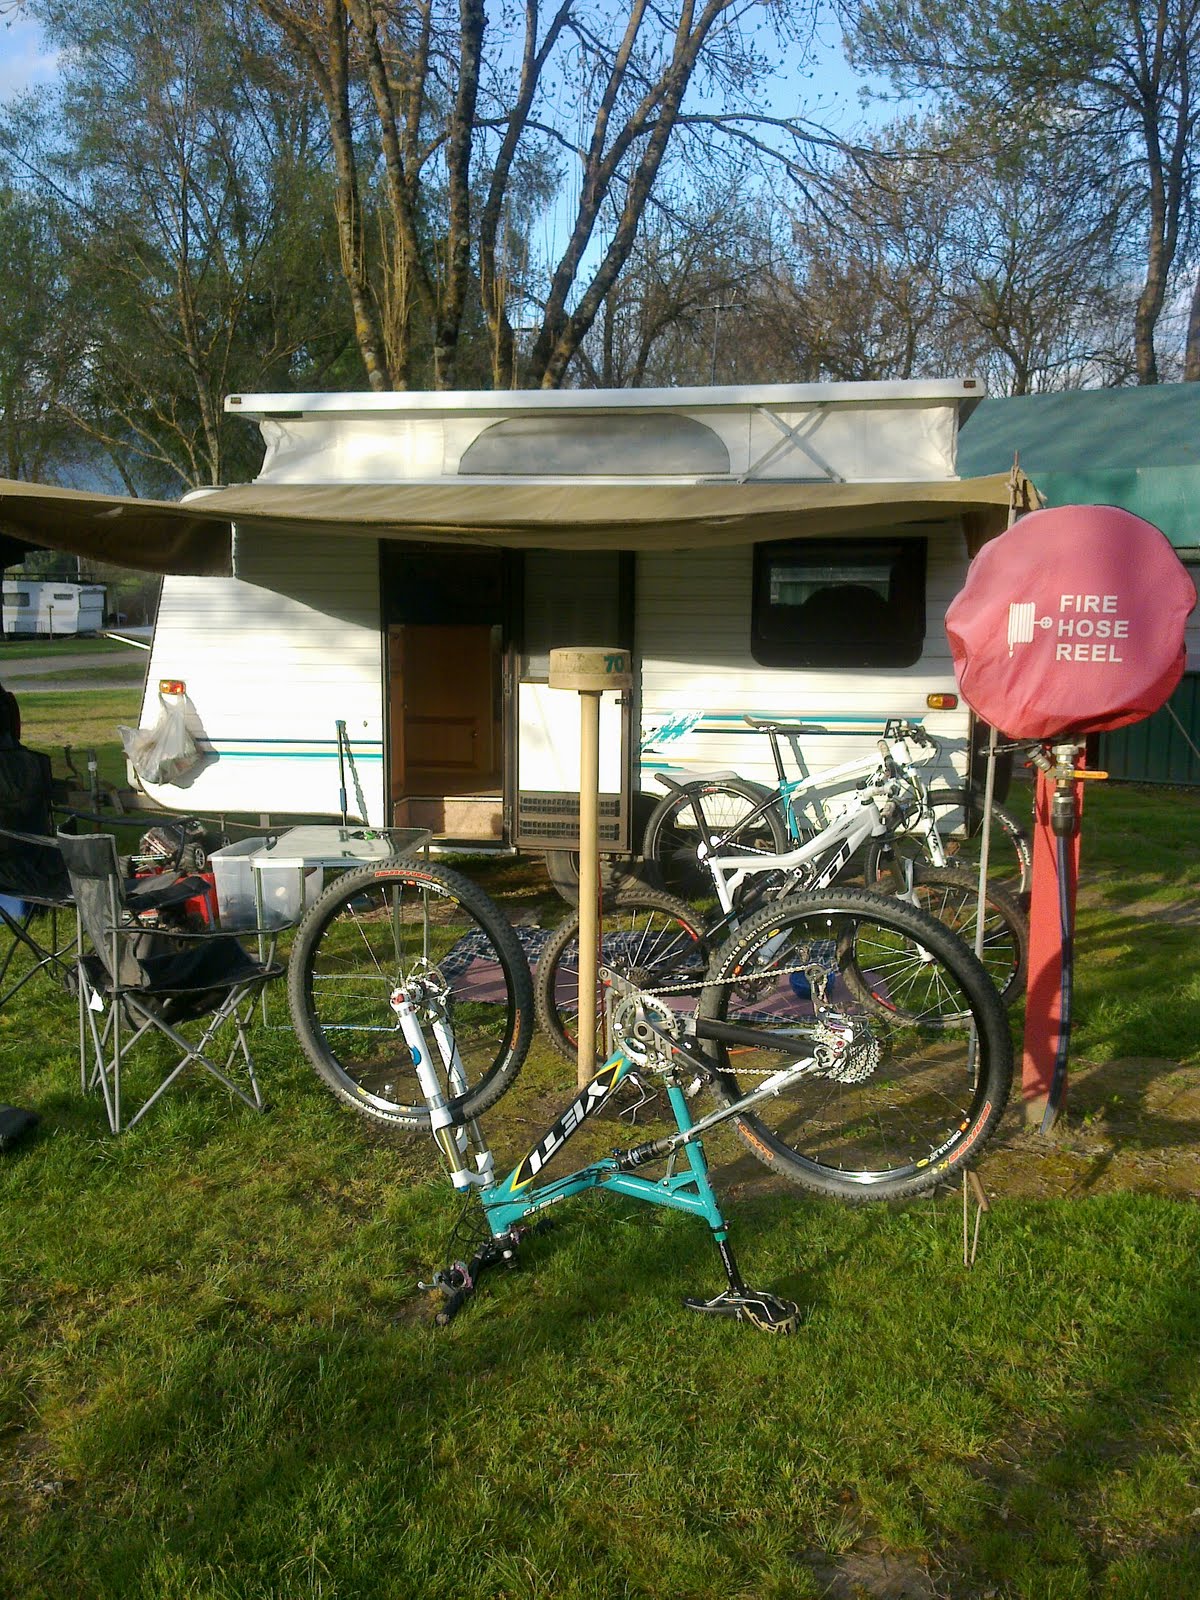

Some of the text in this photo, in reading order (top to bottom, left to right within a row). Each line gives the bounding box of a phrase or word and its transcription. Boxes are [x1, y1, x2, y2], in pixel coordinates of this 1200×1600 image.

[1059, 594, 1118, 614] FIRE
[1057, 619, 1130, 639] HOSE
[1055, 643, 1123, 663] REEL
[603, 655, 625, 673] 70
[528, 1080, 609, 1176] YETI
